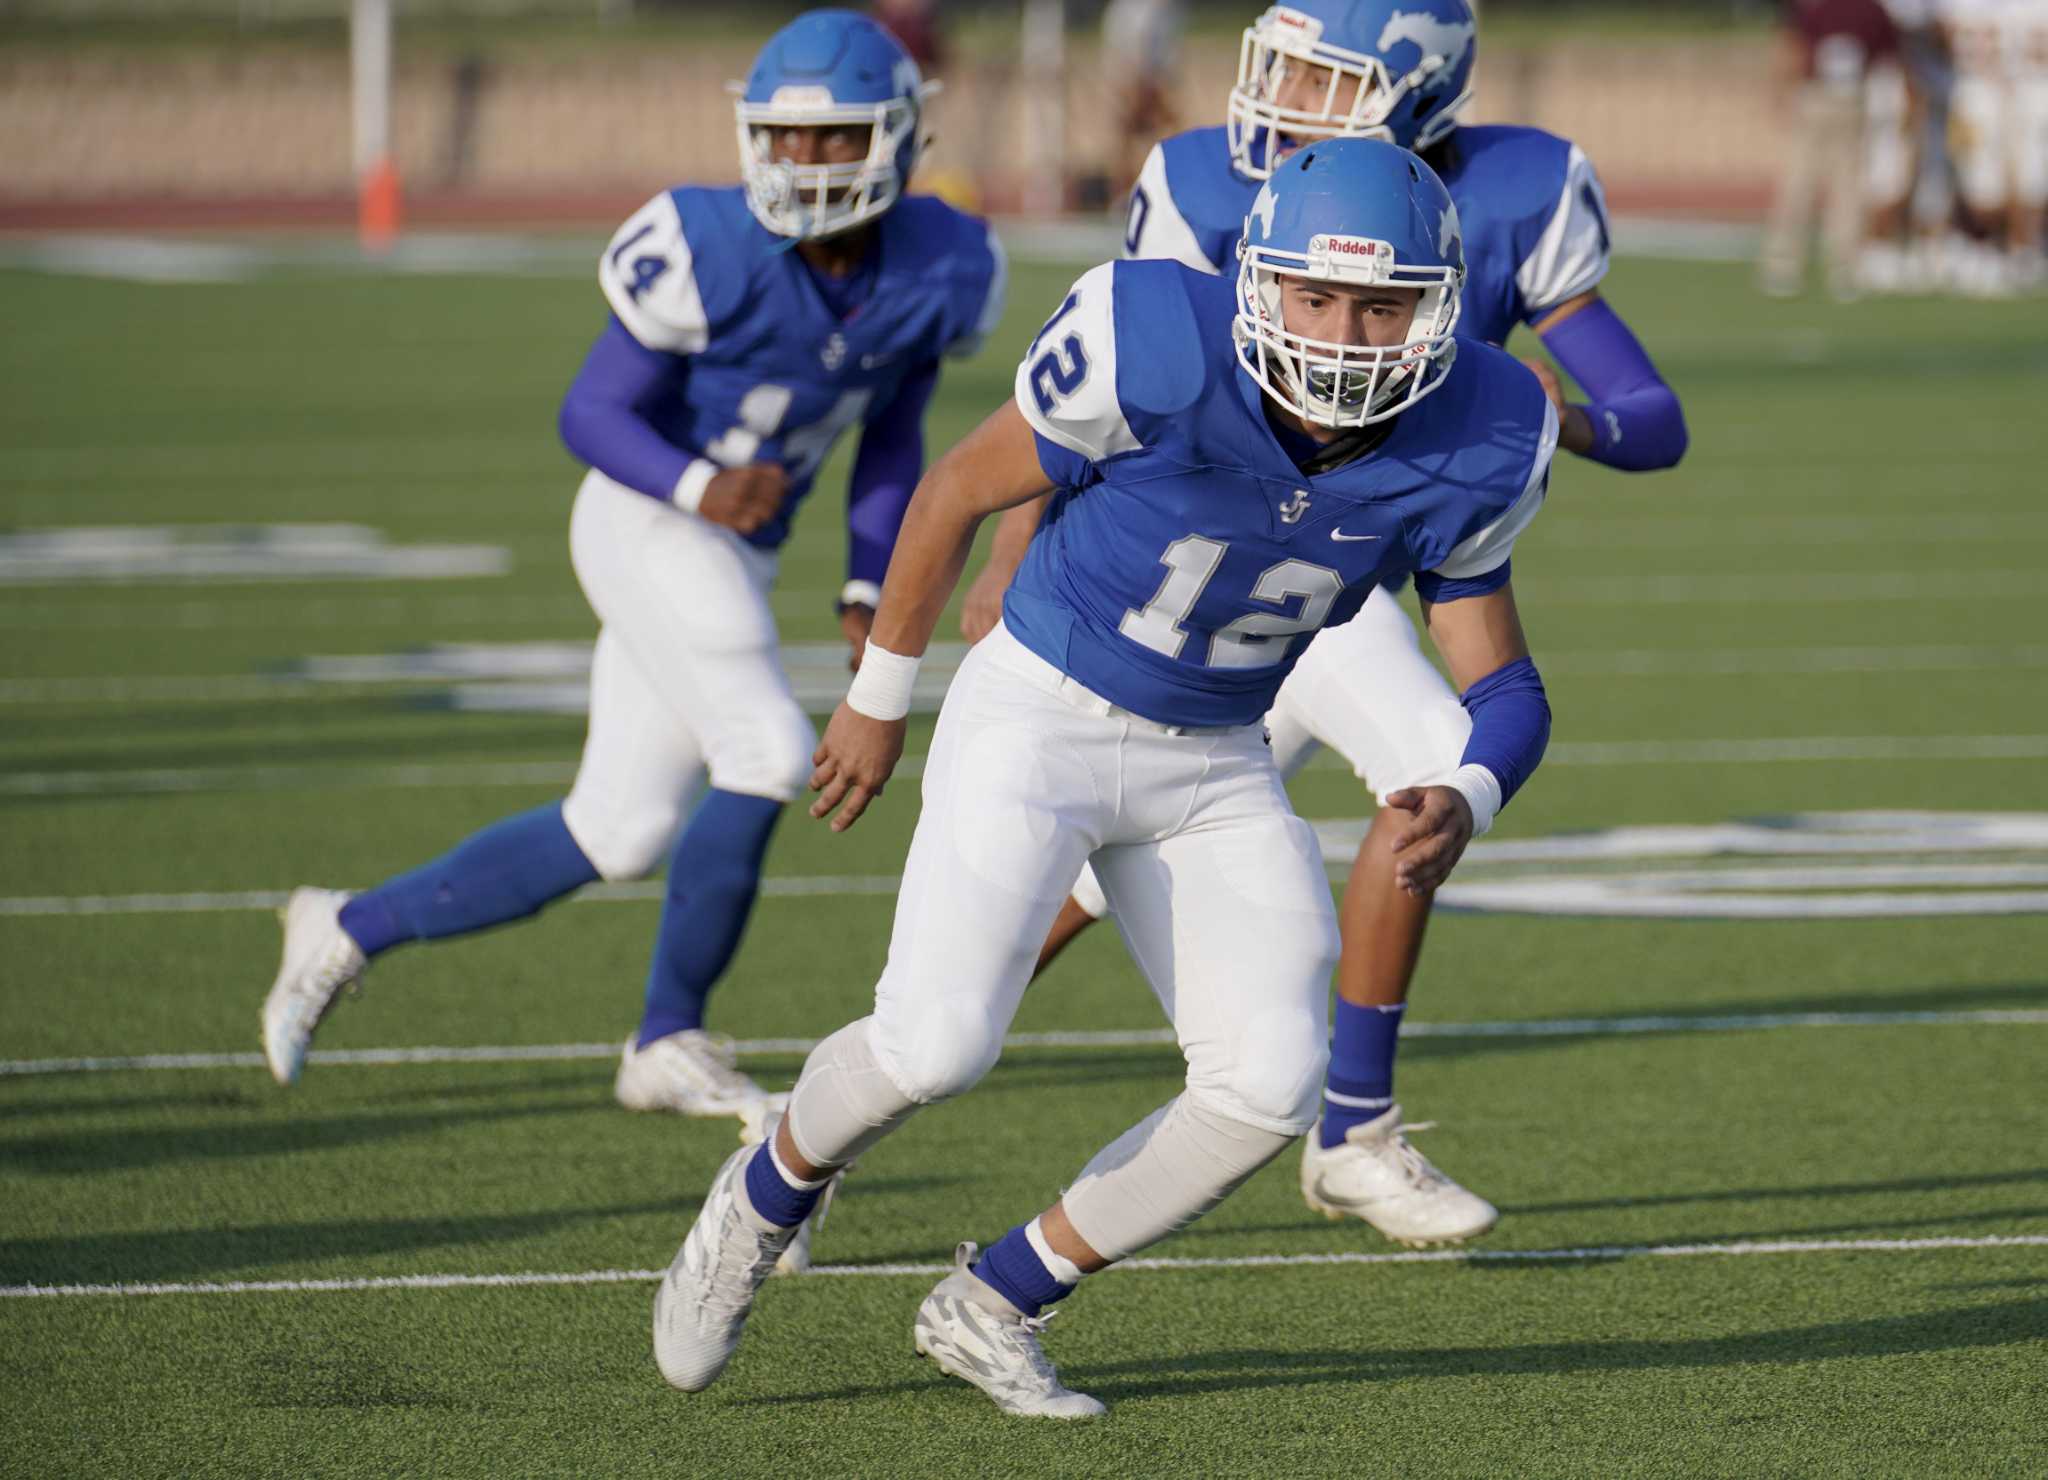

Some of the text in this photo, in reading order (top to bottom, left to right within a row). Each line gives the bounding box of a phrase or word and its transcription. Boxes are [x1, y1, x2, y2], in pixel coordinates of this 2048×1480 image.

[611, 223, 670, 306] 14
[1328, 238, 1376, 256] Riddell
[1028, 289, 1092, 418] 12
[1118, 533, 1345, 668] 12
